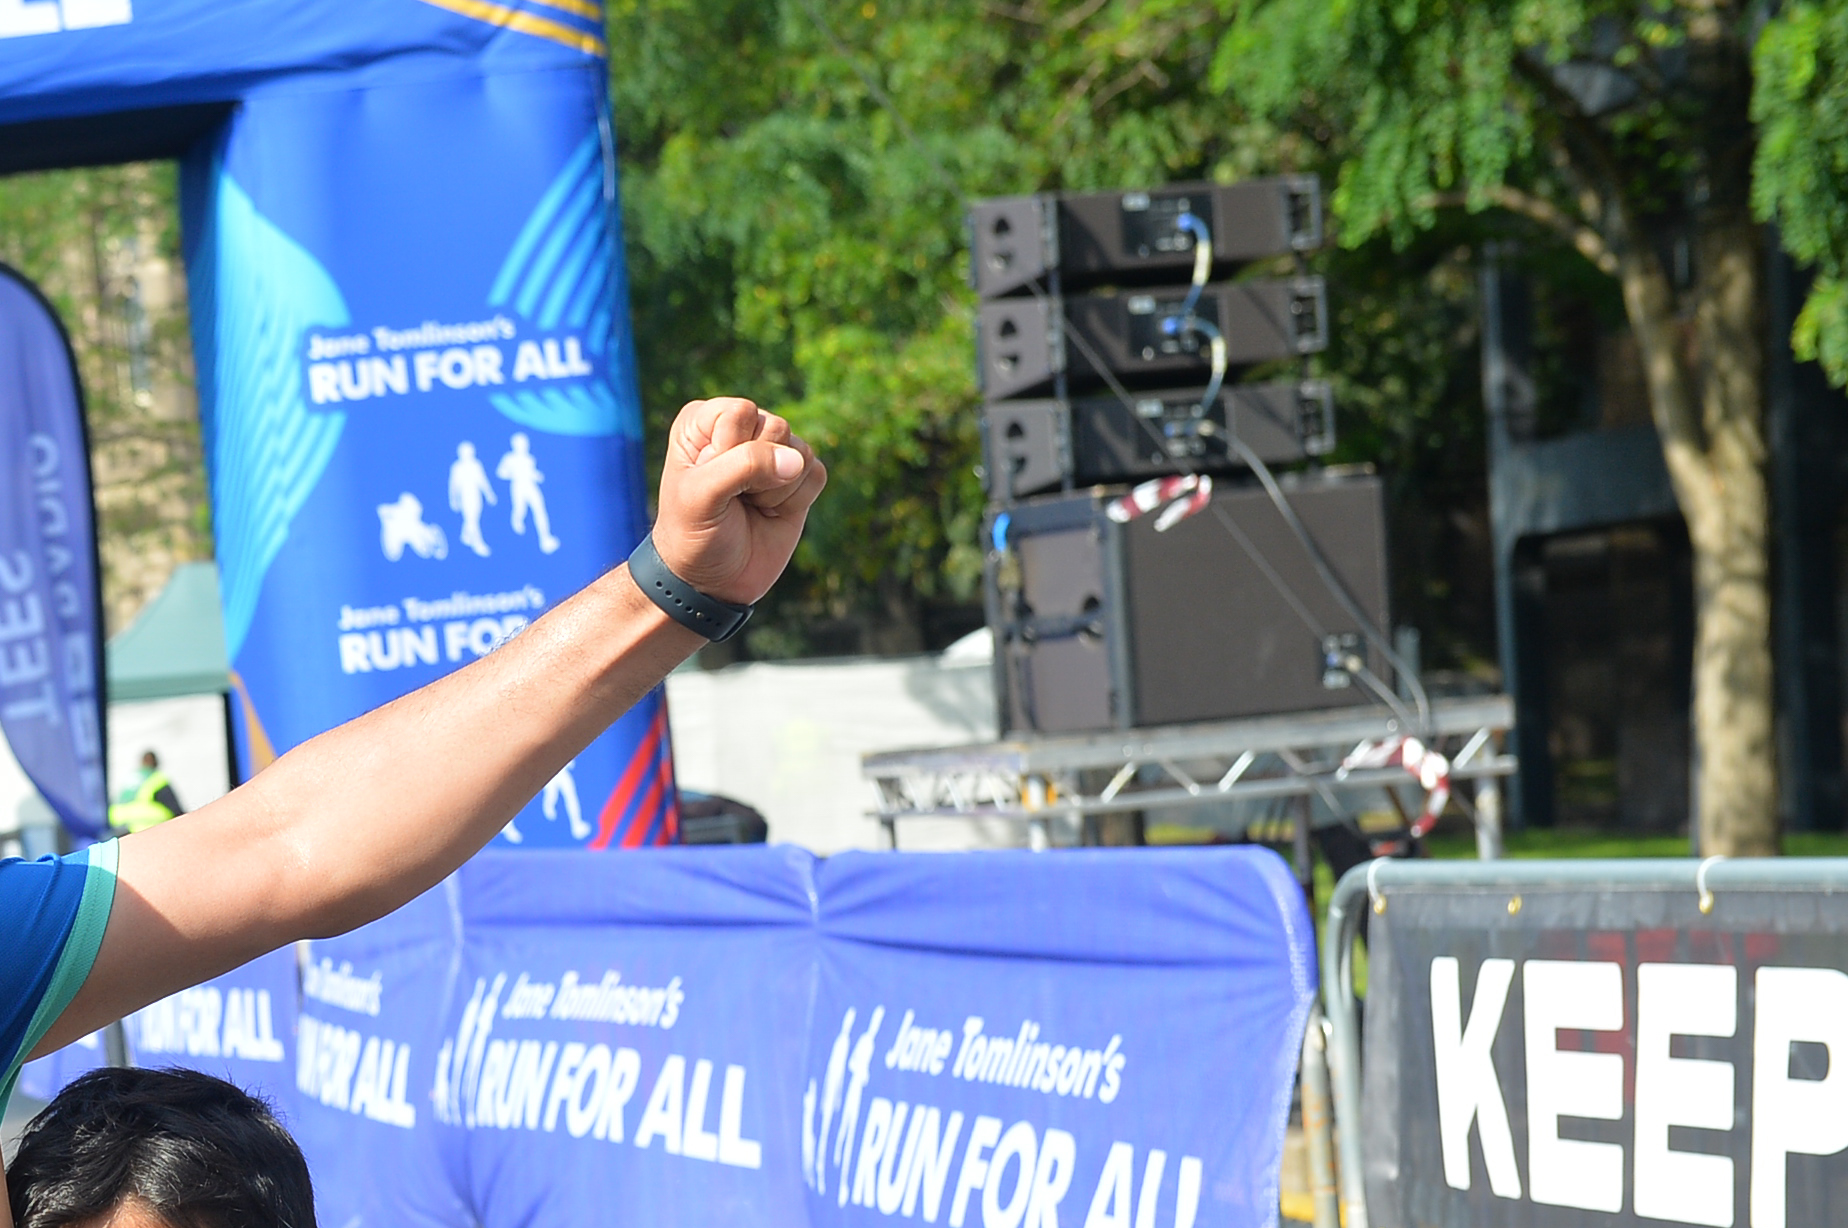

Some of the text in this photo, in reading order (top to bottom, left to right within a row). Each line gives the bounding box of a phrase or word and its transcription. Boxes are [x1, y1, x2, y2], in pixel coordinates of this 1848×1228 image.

[308, 336, 593, 404] RUN FOR ALL
[338, 624, 439, 675] RUN
[222, 987, 285, 1063] ALL
[502, 969, 685, 1030] Jane Tomlinson's
[351, 1034, 417, 1130] ALL
[885, 1008, 1126, 1104] Jane Tomlinson's
[475, 1038, 762, 1169] RUN FOR ALL
[851, 1096, 964, 1225] RUN
